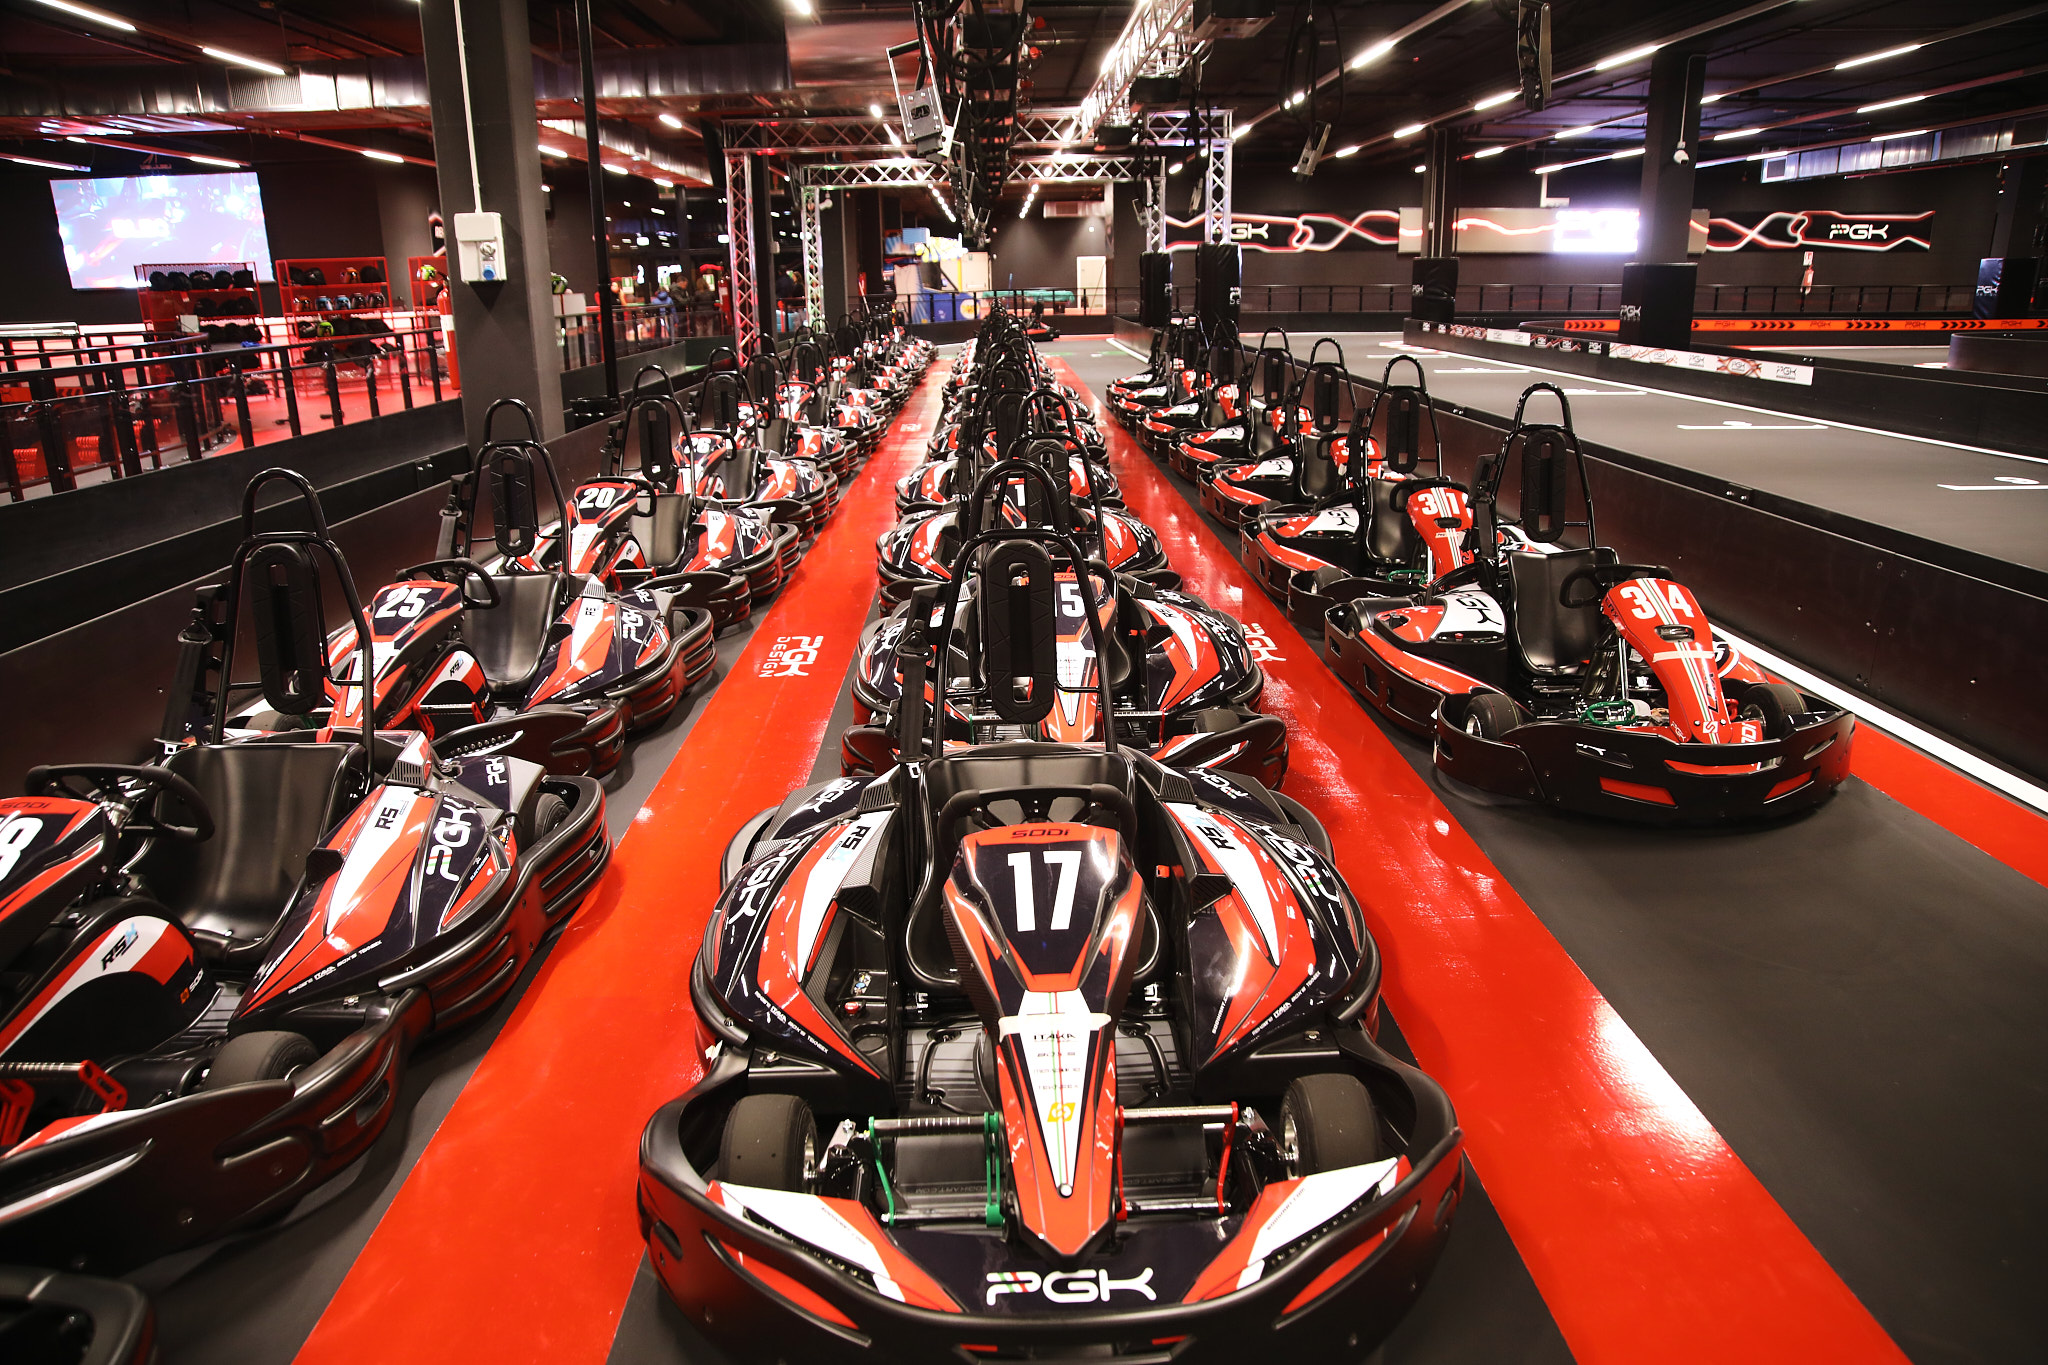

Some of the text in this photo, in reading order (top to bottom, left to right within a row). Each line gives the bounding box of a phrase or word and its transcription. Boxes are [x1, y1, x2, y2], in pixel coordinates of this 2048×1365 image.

[1214, 222, 1269, 240] GK
[1829, 223, 1889, 240] PGK
[1620, 305, 1642, 317] PGK
[578, 488, 617, 509] 20
[374, 587, 432, 619] 25
[758, 636, 791, 678] DESIGN
[774, 636, 824, 677] PGK
[486, 756, 508, 786] PGK
[426, 802, 478, 882] PGK
[1011, 828, 1070, 839] SODI
[1007, 850, 1082, 932] 17
[986, 1267, 1157, 1306] PGK
